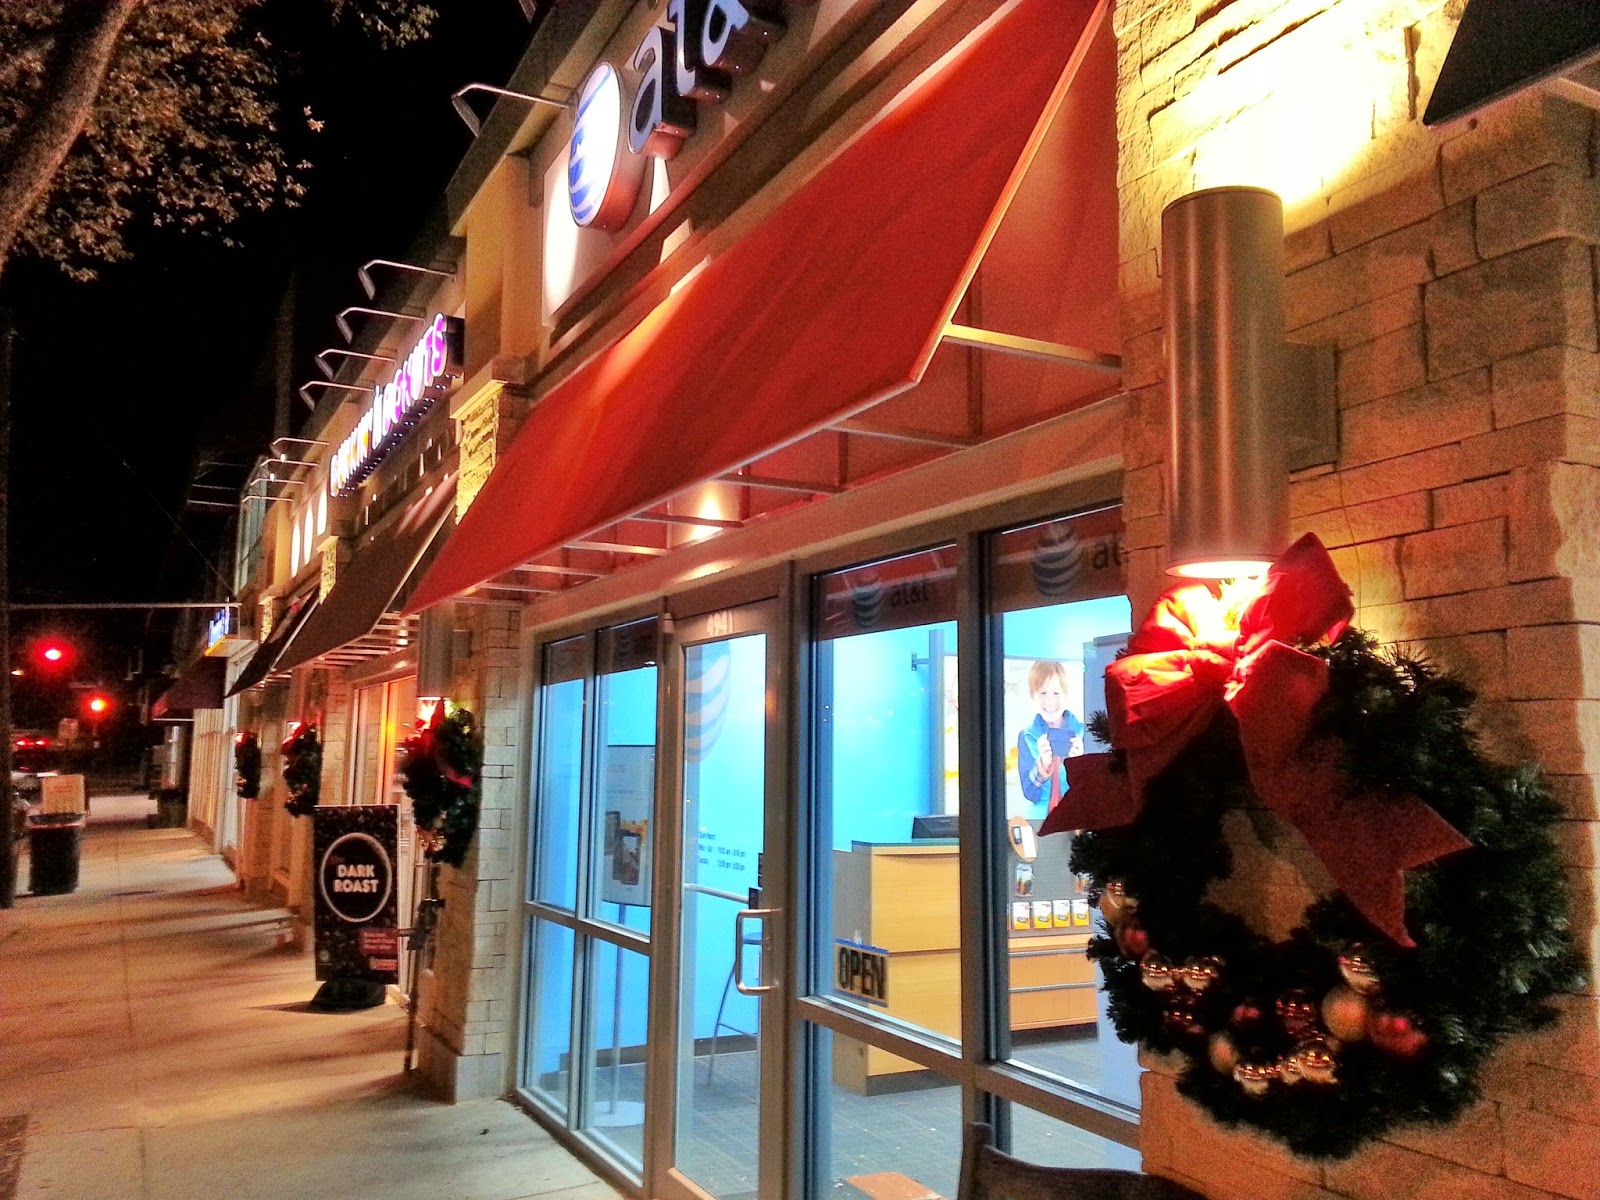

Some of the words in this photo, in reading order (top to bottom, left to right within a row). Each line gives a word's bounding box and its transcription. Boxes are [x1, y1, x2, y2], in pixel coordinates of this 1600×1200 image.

[337, 864, 376, 878] DARK
[333, 879, 379, 893] ROAST
[838, 946, 887, 1000] OPEN
